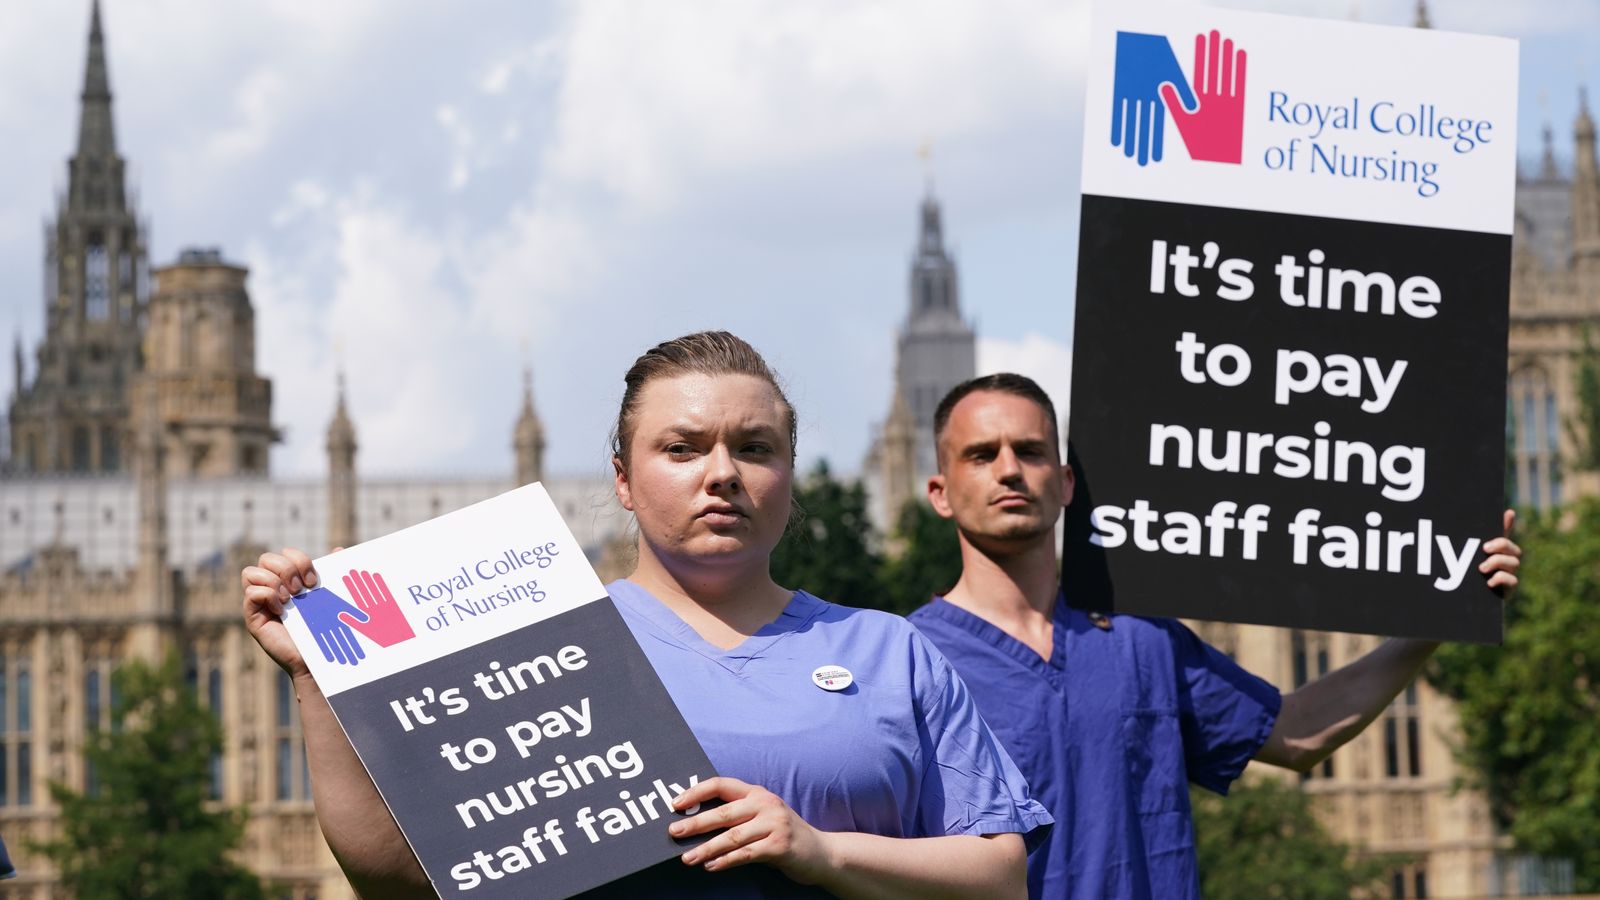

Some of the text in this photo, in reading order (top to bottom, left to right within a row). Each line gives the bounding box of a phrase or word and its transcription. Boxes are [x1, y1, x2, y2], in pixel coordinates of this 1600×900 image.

[1268, 91, 1493, 153] Royal College
[1264, 138, 1440, 197] of Nursing
[1150, 240, 1441, 318] It's time
[1176, 331, 1408, 414] to pay
[1149, 421, 1425, 501] nursing
[407, 541, 560, 606] Royal College
[1090, 499, 1480, 591] staff fairly
[425, 579, 546, 632] of Nursing
[389, 644, 589, 732] It's time
[440, 697, 593, 772] to pay
[455, 741, 644, 829] nursing
[450, 819, 568, 891] staff
